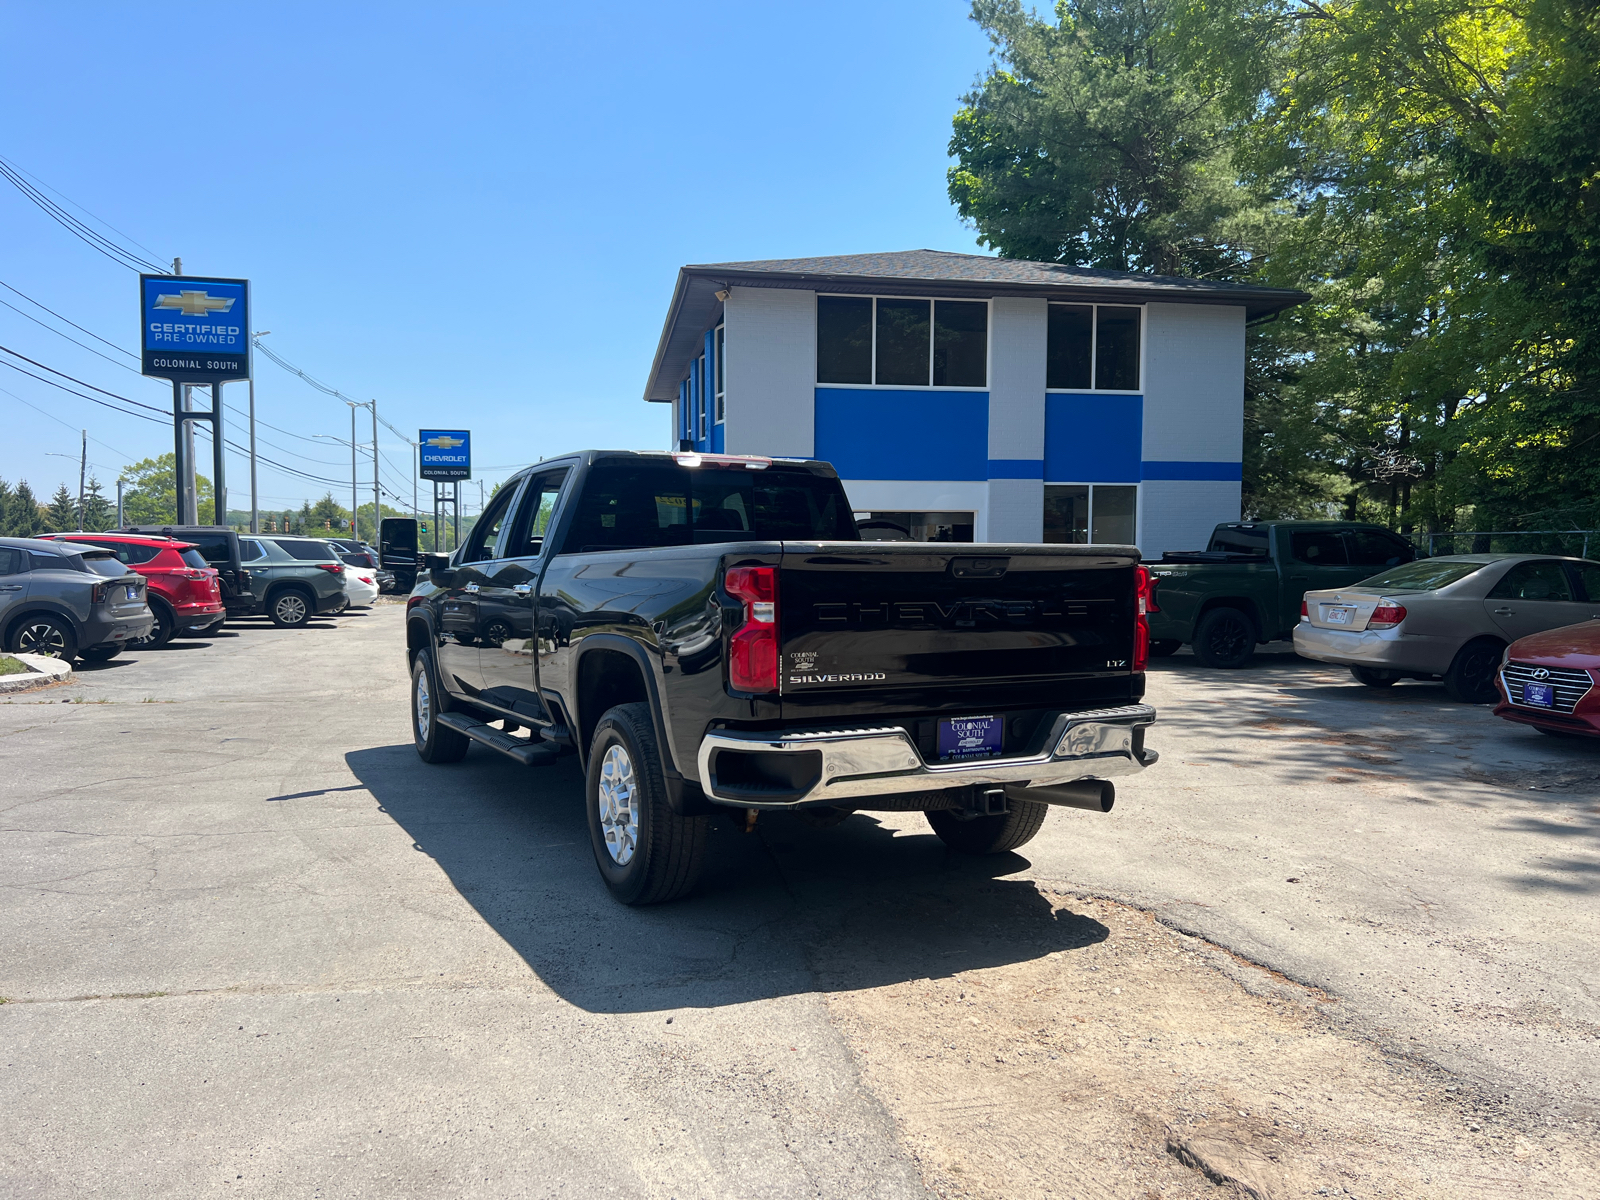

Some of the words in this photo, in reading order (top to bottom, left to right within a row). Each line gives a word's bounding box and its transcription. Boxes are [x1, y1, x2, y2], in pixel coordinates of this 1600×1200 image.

[150, 323, 240, 335] CERTIFIED
[155, 333, 236, 344] PRE-OWNED
[153, 359, 201, 369] COLONIAL
[207, 361, 238, 370] SOUTH
[790, 651, 819, 659] COLONIAL
[1106, 659, 1127, 667] LTZ
[789, 672, 886, 684] SILVERADO
[952, 721, 990, 731] COLONIAL
[957, 729, 985, 738] SOUTH
